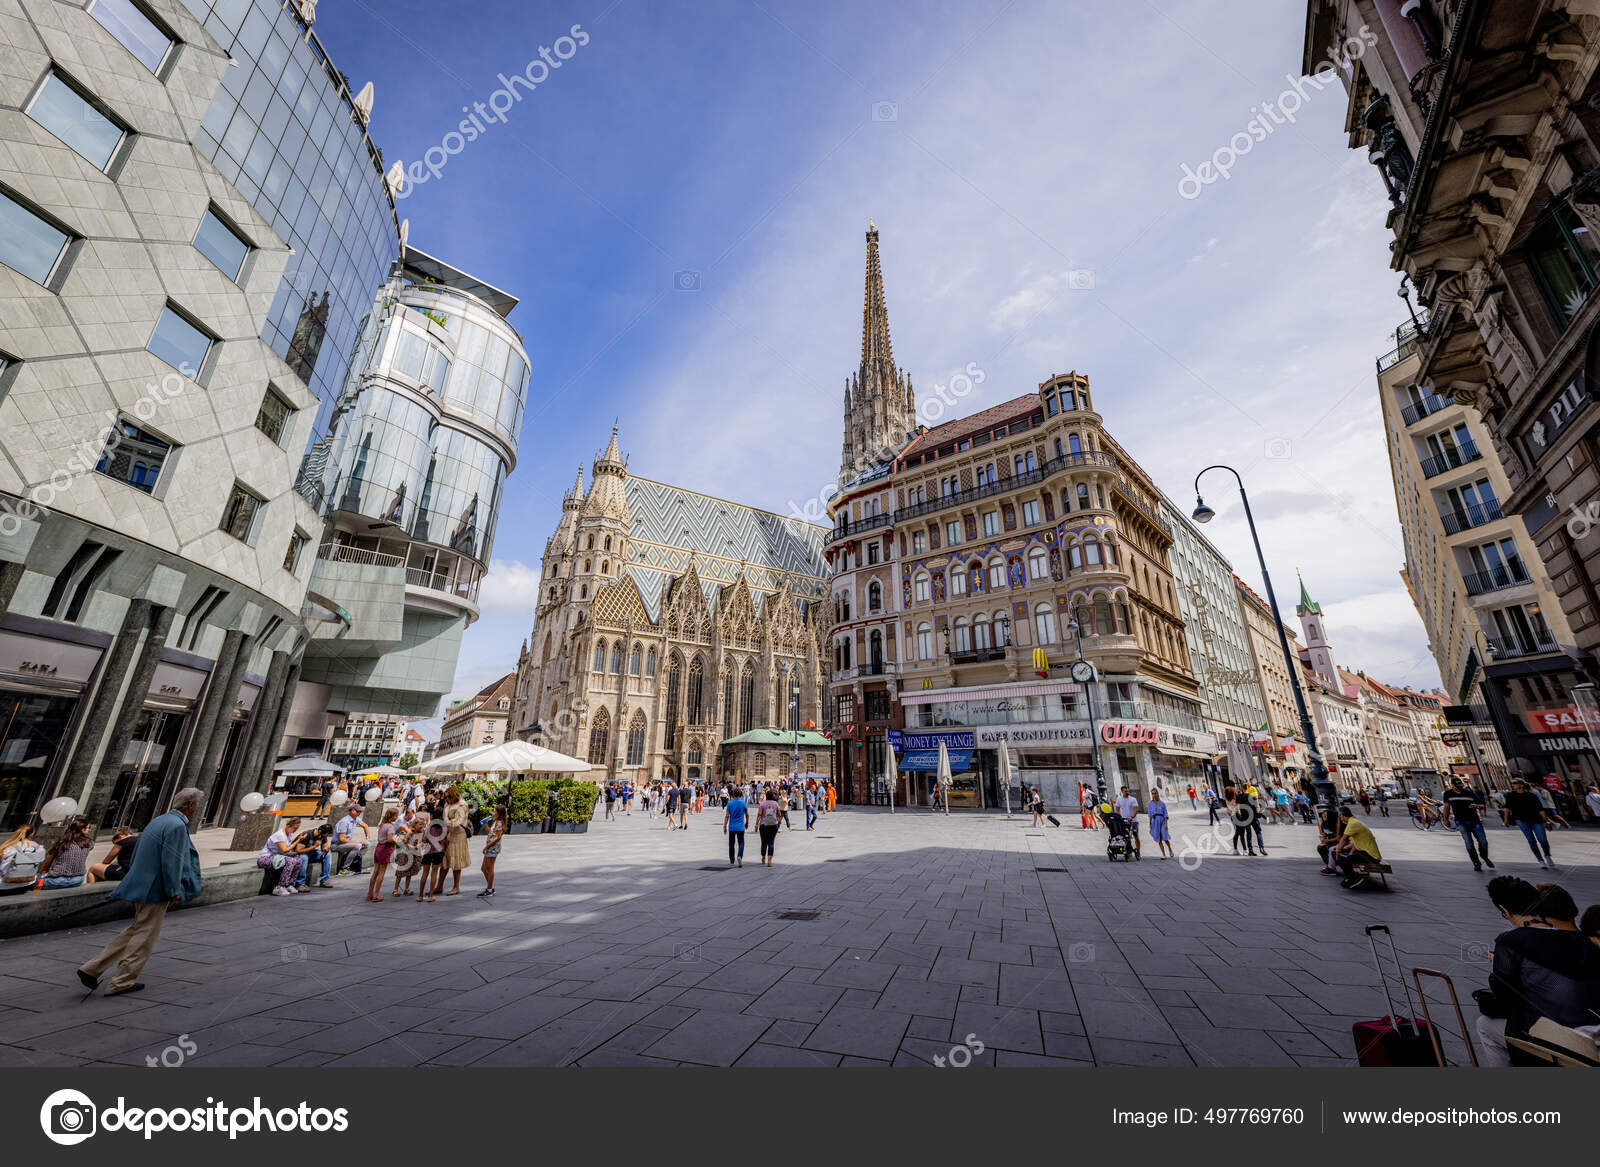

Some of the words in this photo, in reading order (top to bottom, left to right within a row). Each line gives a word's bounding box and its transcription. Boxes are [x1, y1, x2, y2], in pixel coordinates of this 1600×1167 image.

[1190, 580, 1218, 661] HOTEL
[904, 735, 930, 749] MONEY
[932, 732, 974, 748] EXCHANGE
[1012, 728, 1092, 741] KONDITOREI
